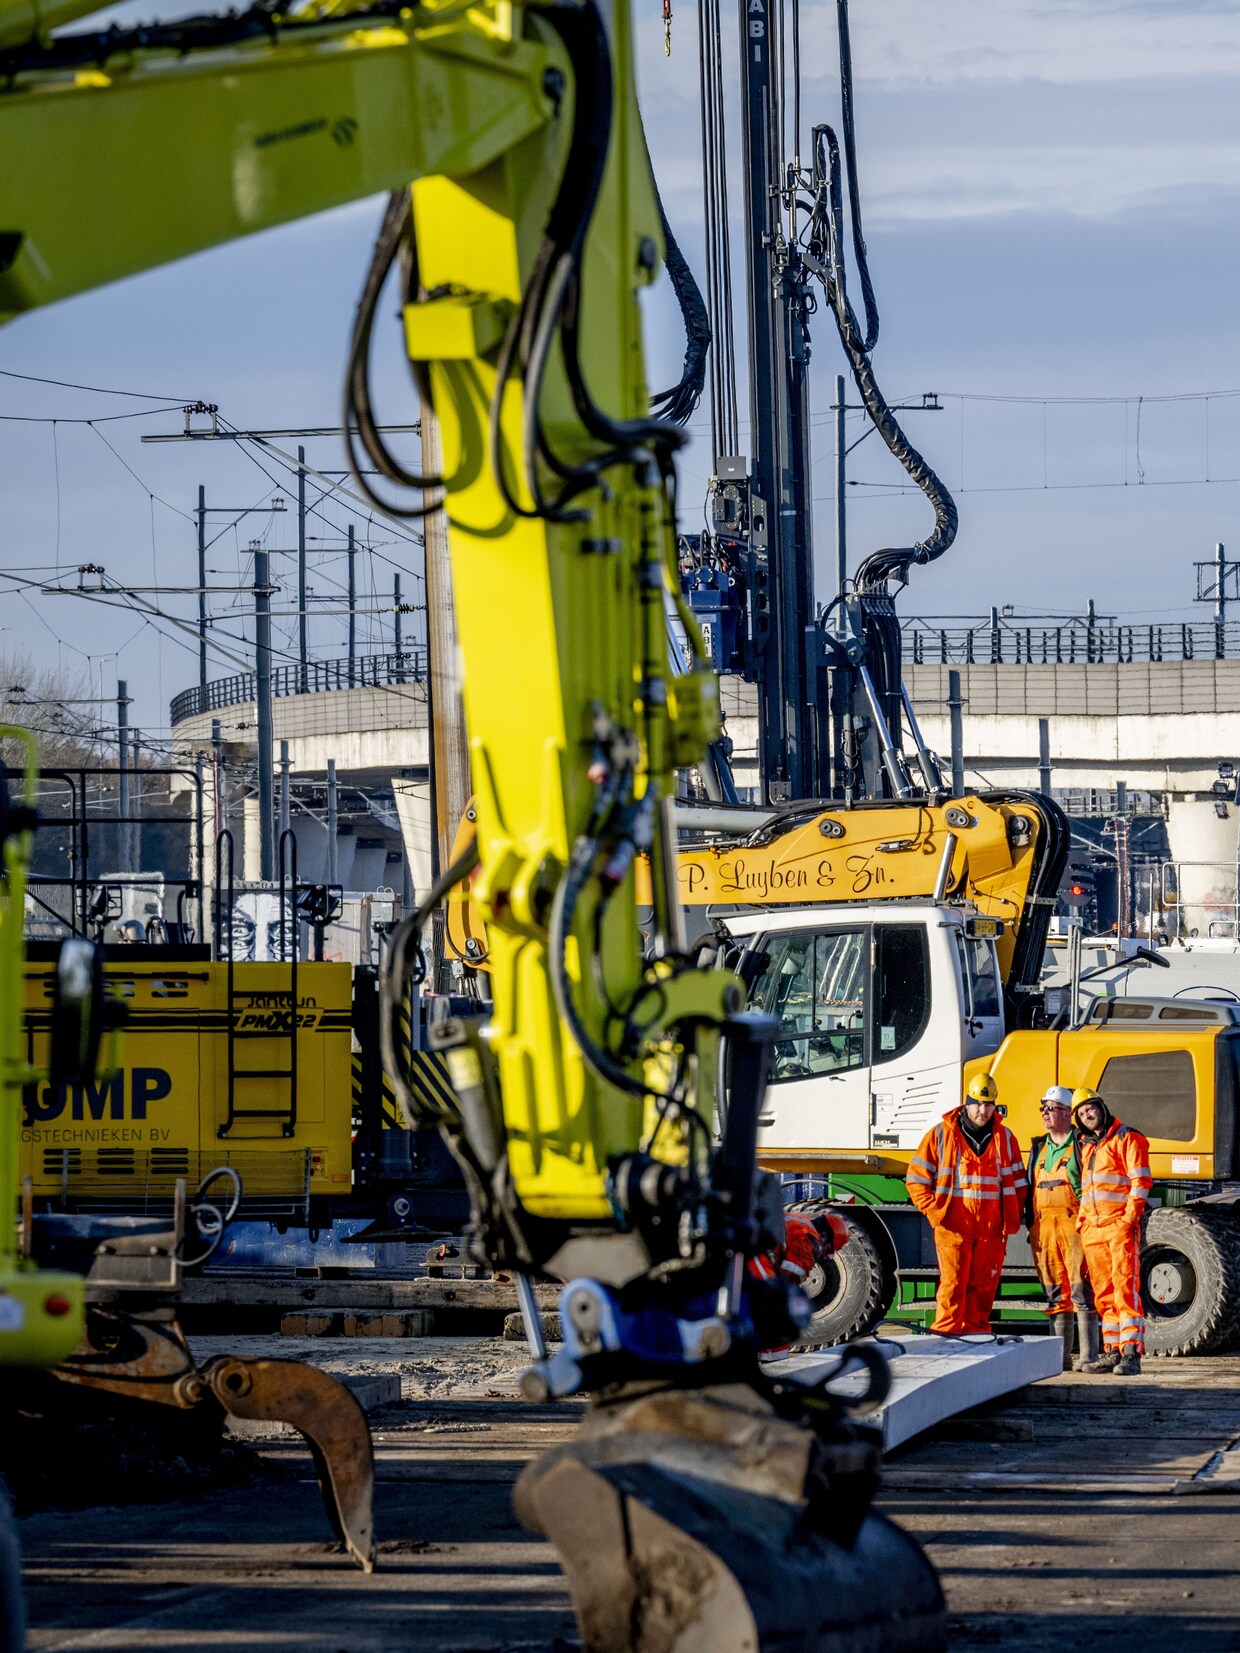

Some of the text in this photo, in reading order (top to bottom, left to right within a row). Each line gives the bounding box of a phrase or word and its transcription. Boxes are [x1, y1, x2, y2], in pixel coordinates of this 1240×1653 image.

[749, 0, 765, 62] ABI
[676, 855, 895, 898] P. Luyben & Zn.
[150, 1128, 170, 1141] BV
